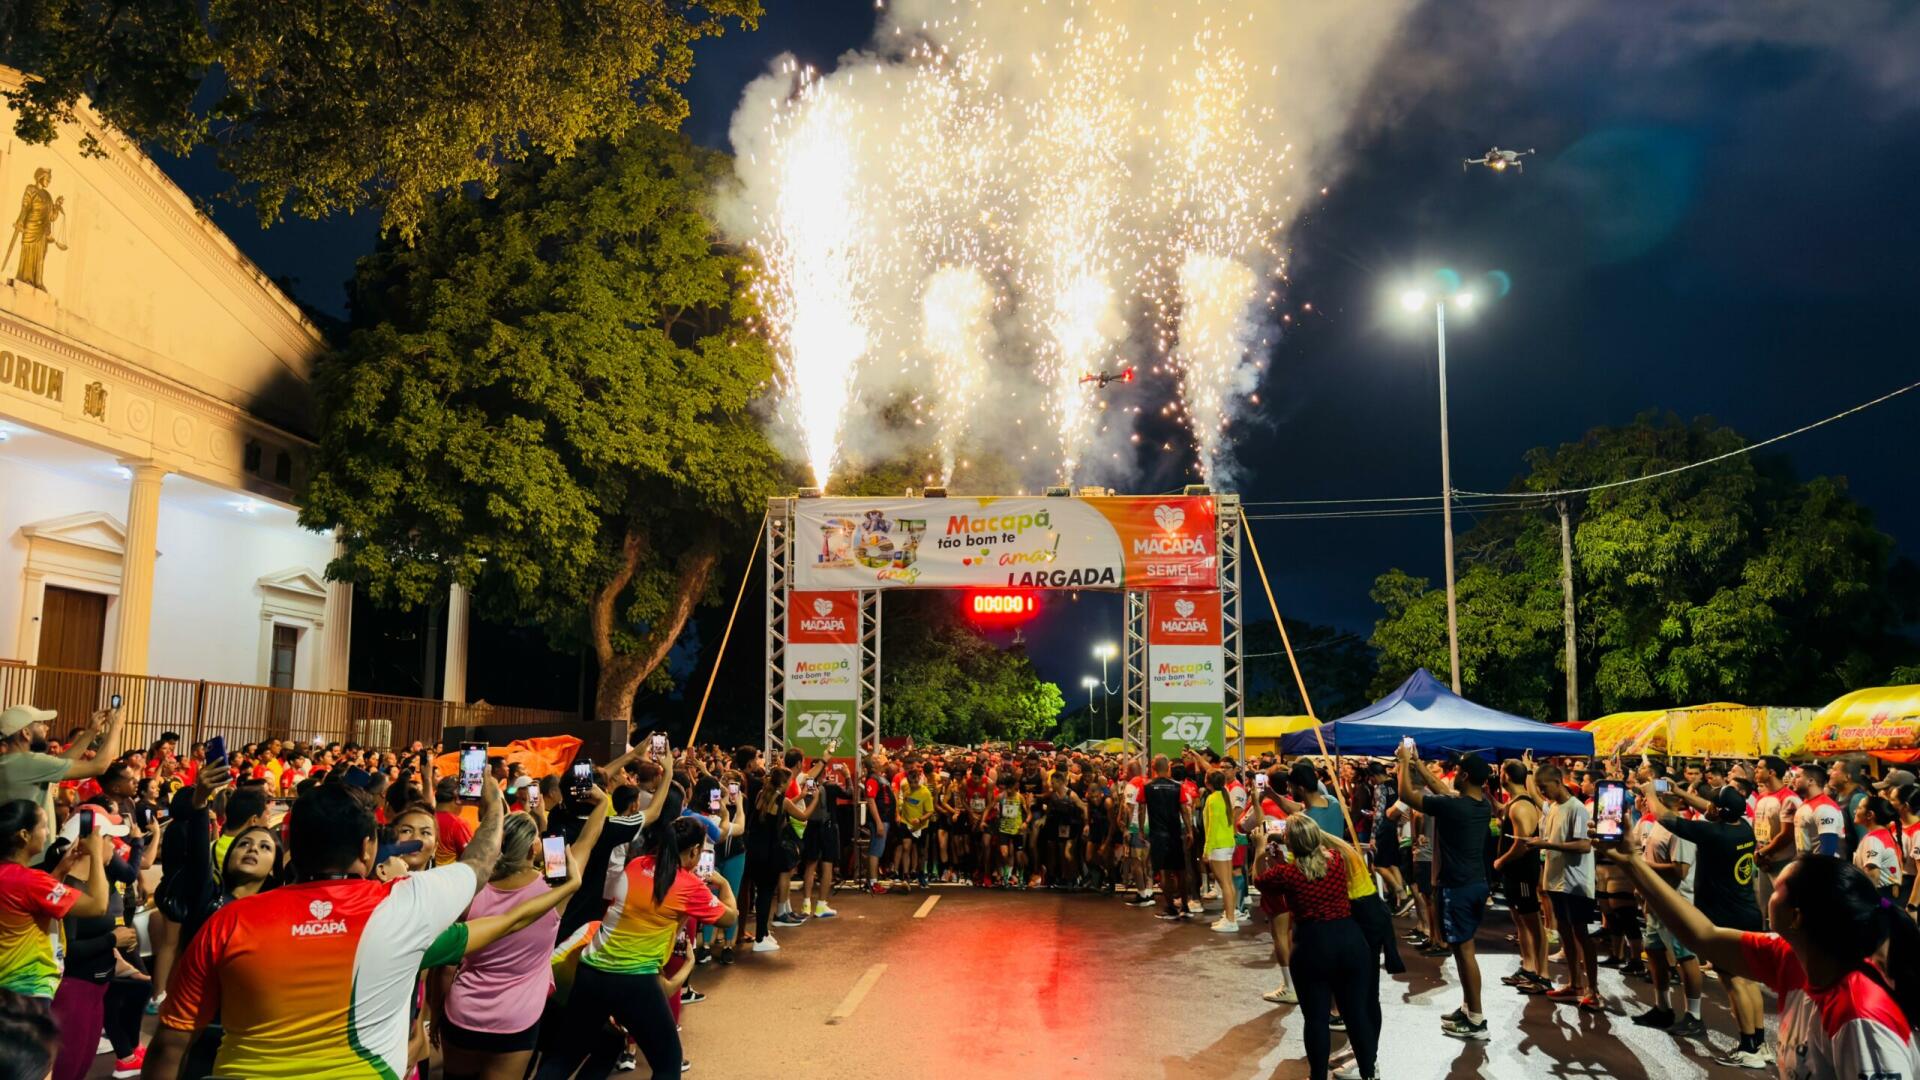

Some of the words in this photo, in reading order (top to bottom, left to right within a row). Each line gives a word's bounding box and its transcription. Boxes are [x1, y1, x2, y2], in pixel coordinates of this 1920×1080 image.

[946, 509, 1053, 535] Macapá,
[937, 536, 961, 549] tão
[966, 535, 997, 546] bom
[1002, 533, 1016, 543] te
[1134, 535, 1206, 554] MACAPÁ
[1008, 567, 1115, 587] LARGADA
[1147, 564, 1199, 576] SEMEL
[801, 617, 845, 631] MACAPÁ
[1161, 618, 1208, 632] MACAPÁ
[797, 713, 847, 737] 267
[1161, 715, 1212, 741] 267
[291, 919, 347, 936] MACAPÁ
